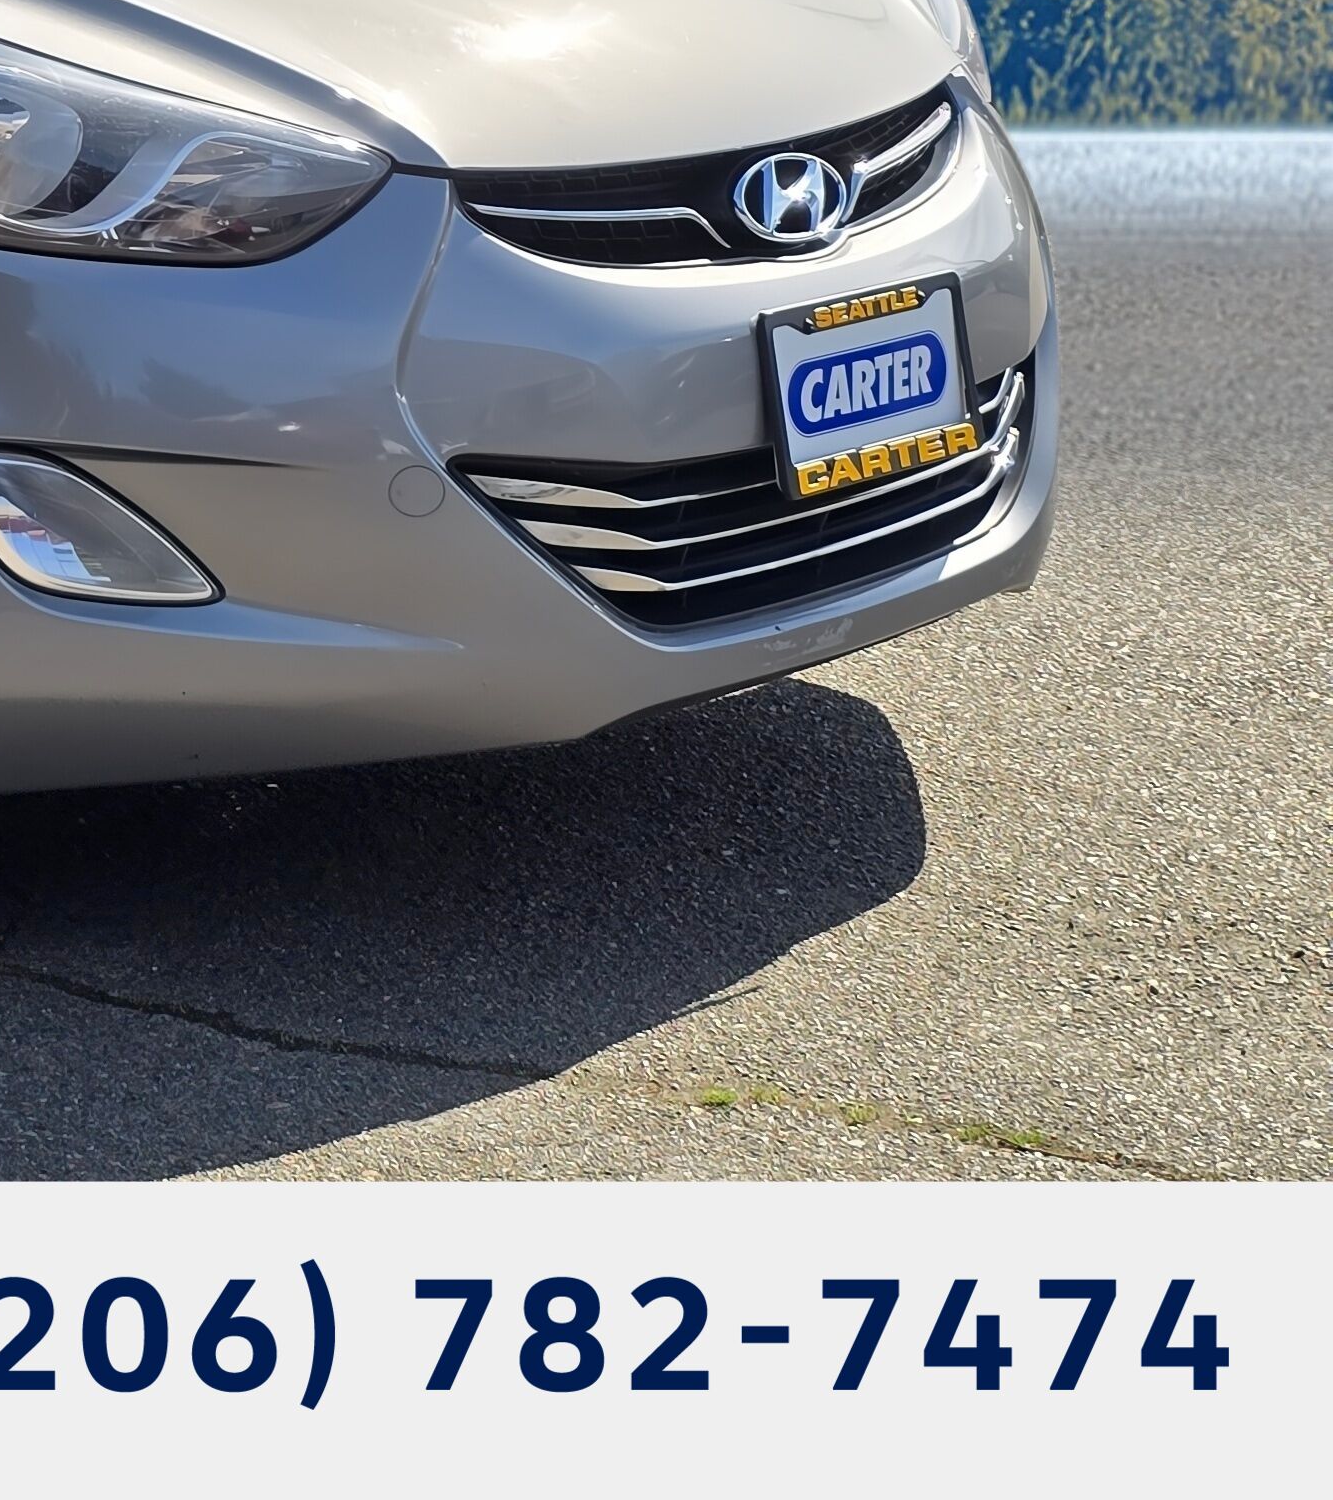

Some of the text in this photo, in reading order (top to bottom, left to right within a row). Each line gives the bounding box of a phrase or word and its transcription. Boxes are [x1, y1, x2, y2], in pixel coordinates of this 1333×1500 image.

[813, 285, 919, 329] SEATTLE
[800, 344, 933, 423] CARTER
[797, 422, 978, 496] CARTER
